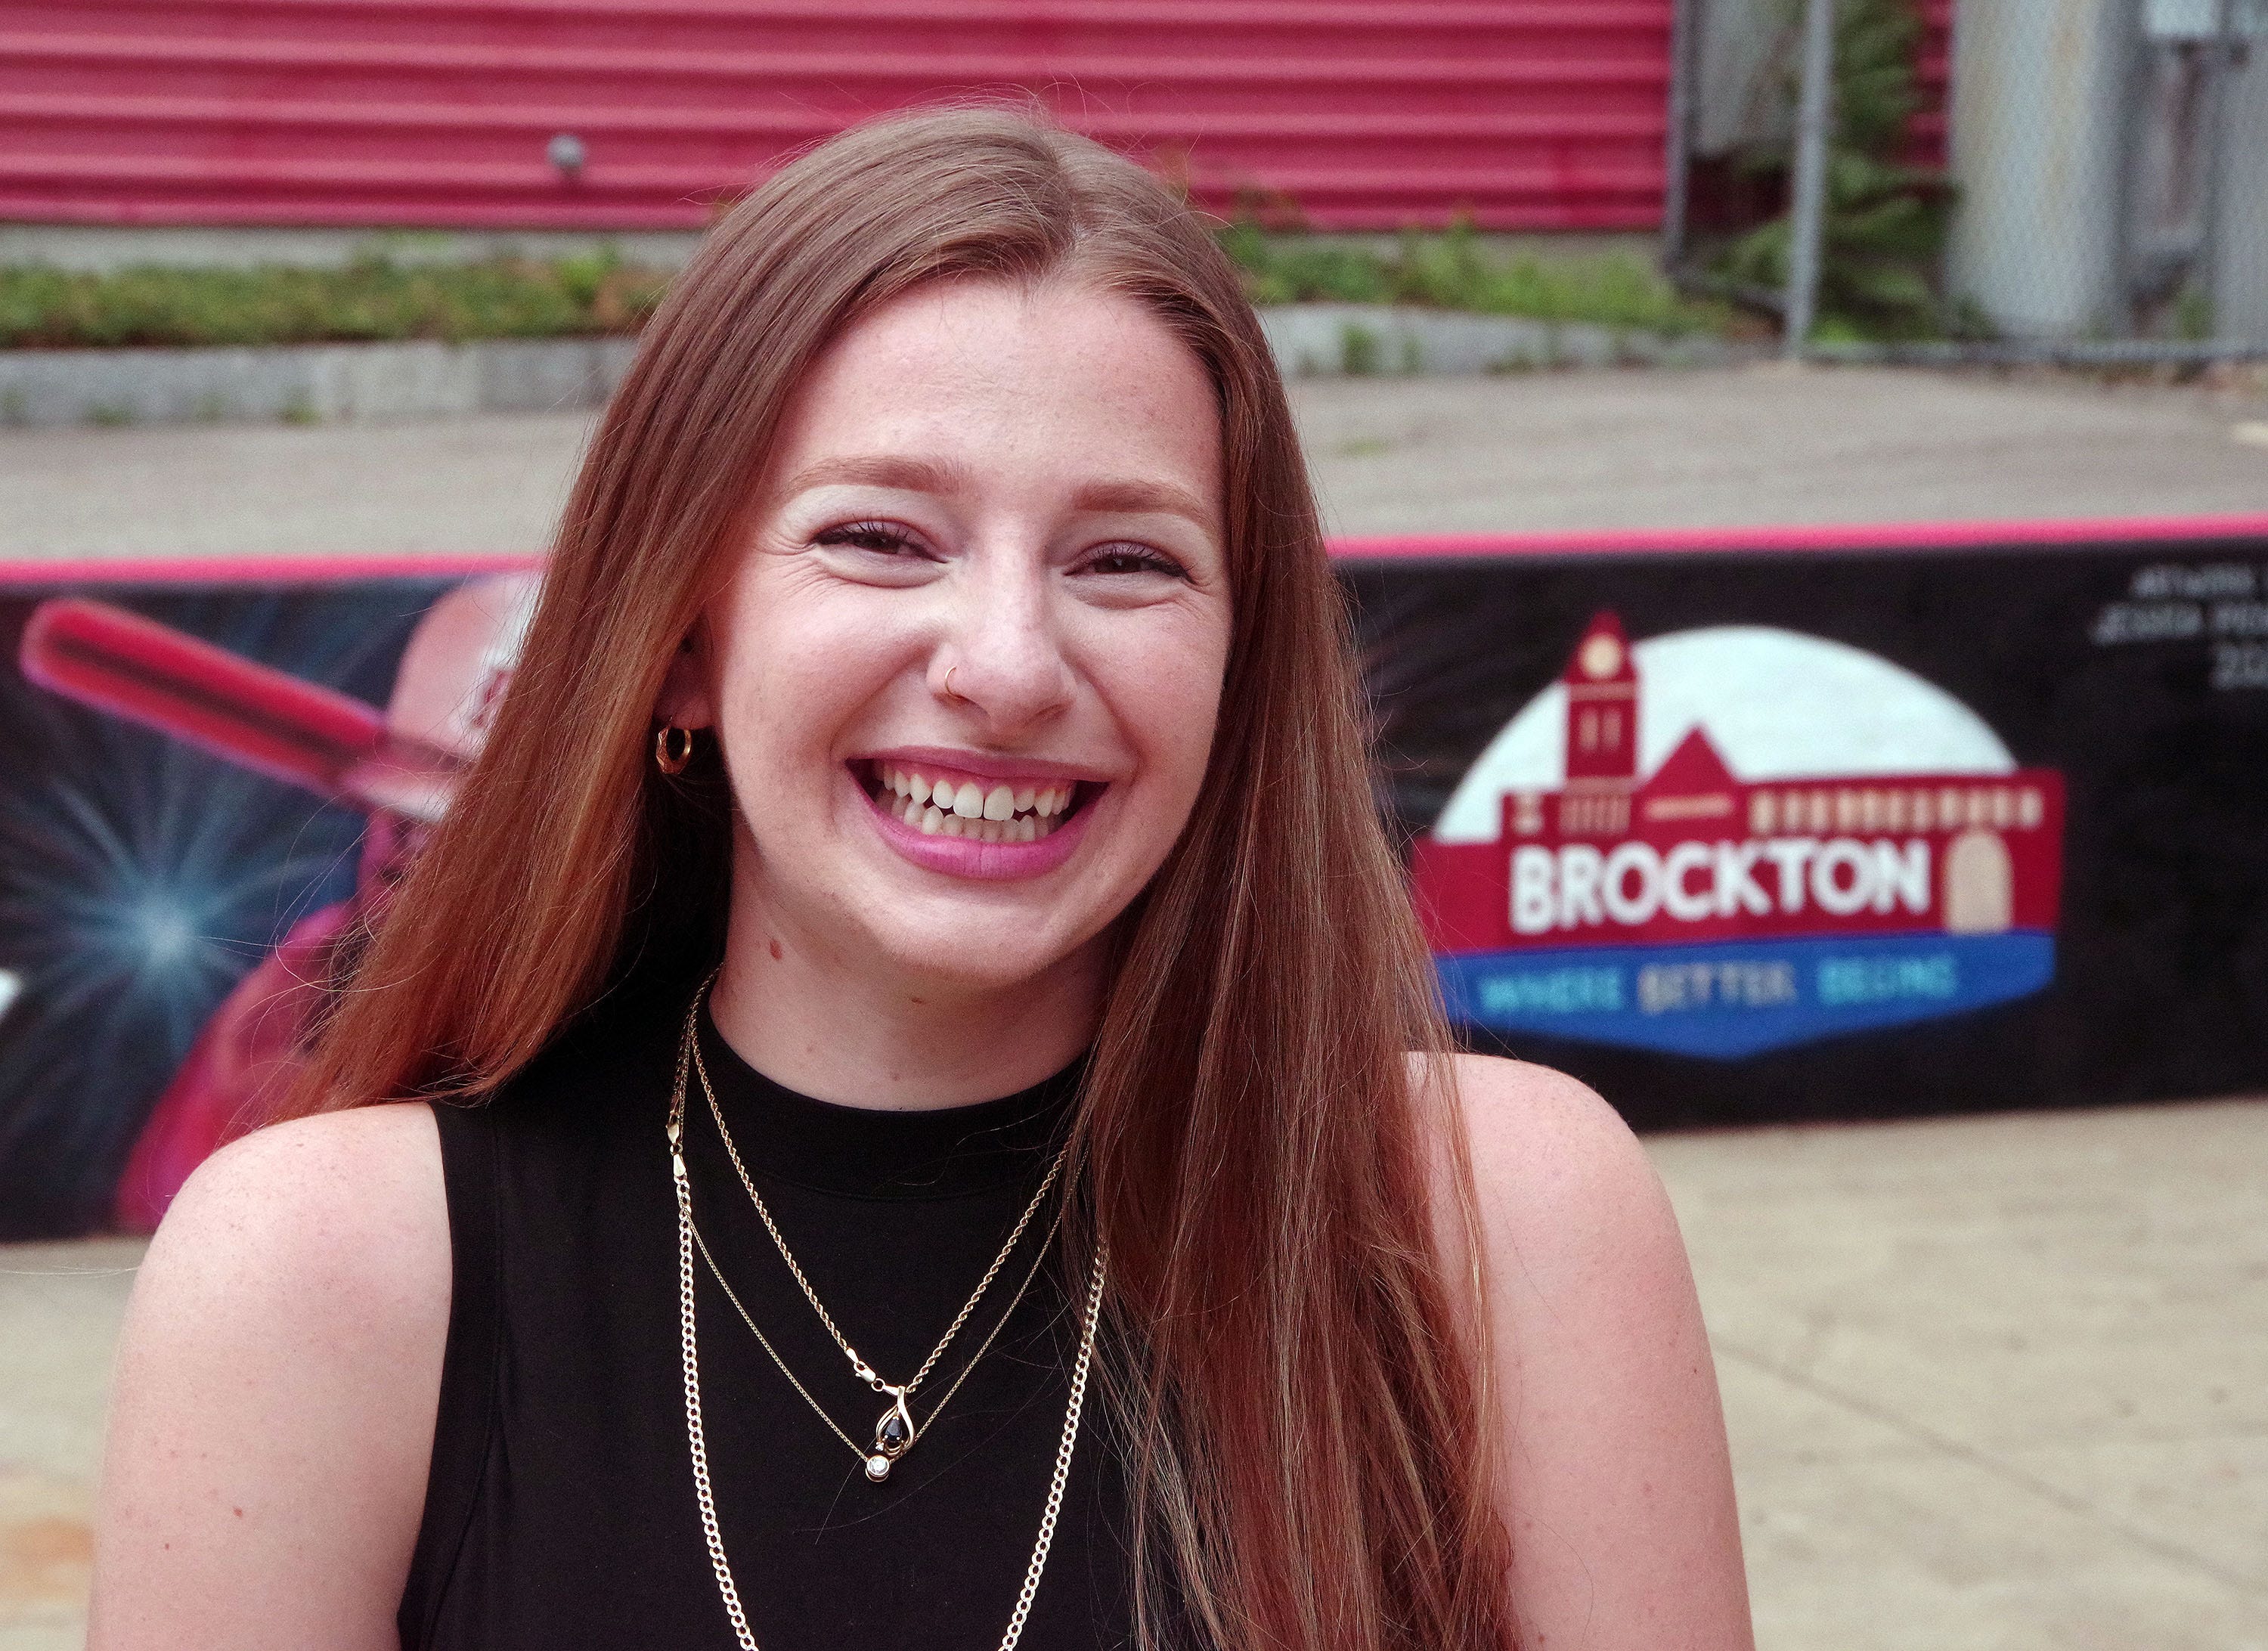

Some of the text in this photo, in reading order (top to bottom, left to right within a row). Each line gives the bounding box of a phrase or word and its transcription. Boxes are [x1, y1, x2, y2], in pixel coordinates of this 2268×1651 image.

[1510, 837, 1931, 935] BROCKTON
[1479, 969, 1625, 1013] WHERE
[1638, 962, 1797, 1015] BETTER
